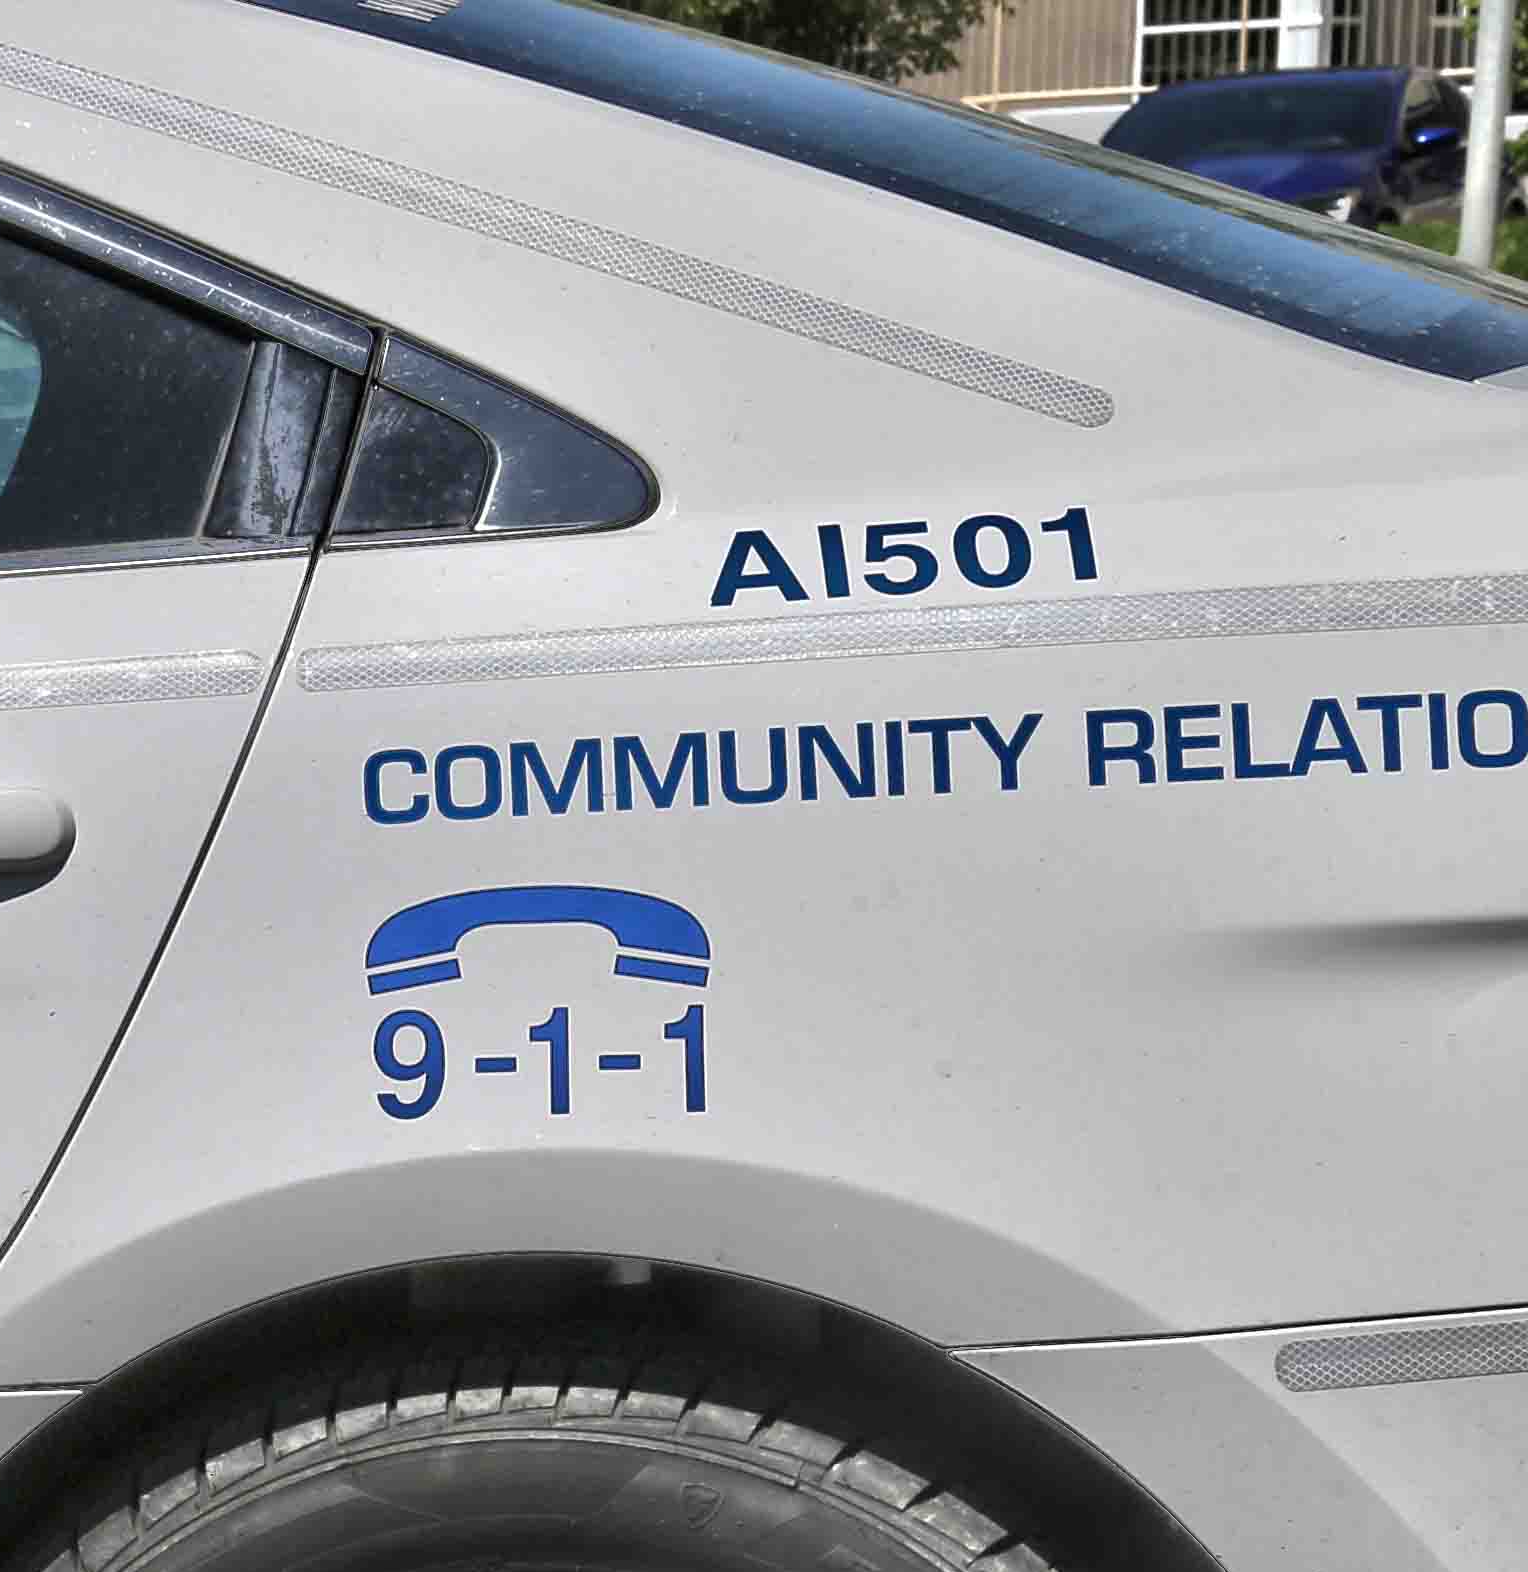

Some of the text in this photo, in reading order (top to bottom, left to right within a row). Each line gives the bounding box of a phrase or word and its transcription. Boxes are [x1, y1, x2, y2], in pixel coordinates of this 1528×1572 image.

[710, 506, 1100, 607] AI501
[361, 689, 1528, 825] COMMUNITY RELATIO
[371, 1004, 707, 1120] 9-1-1
